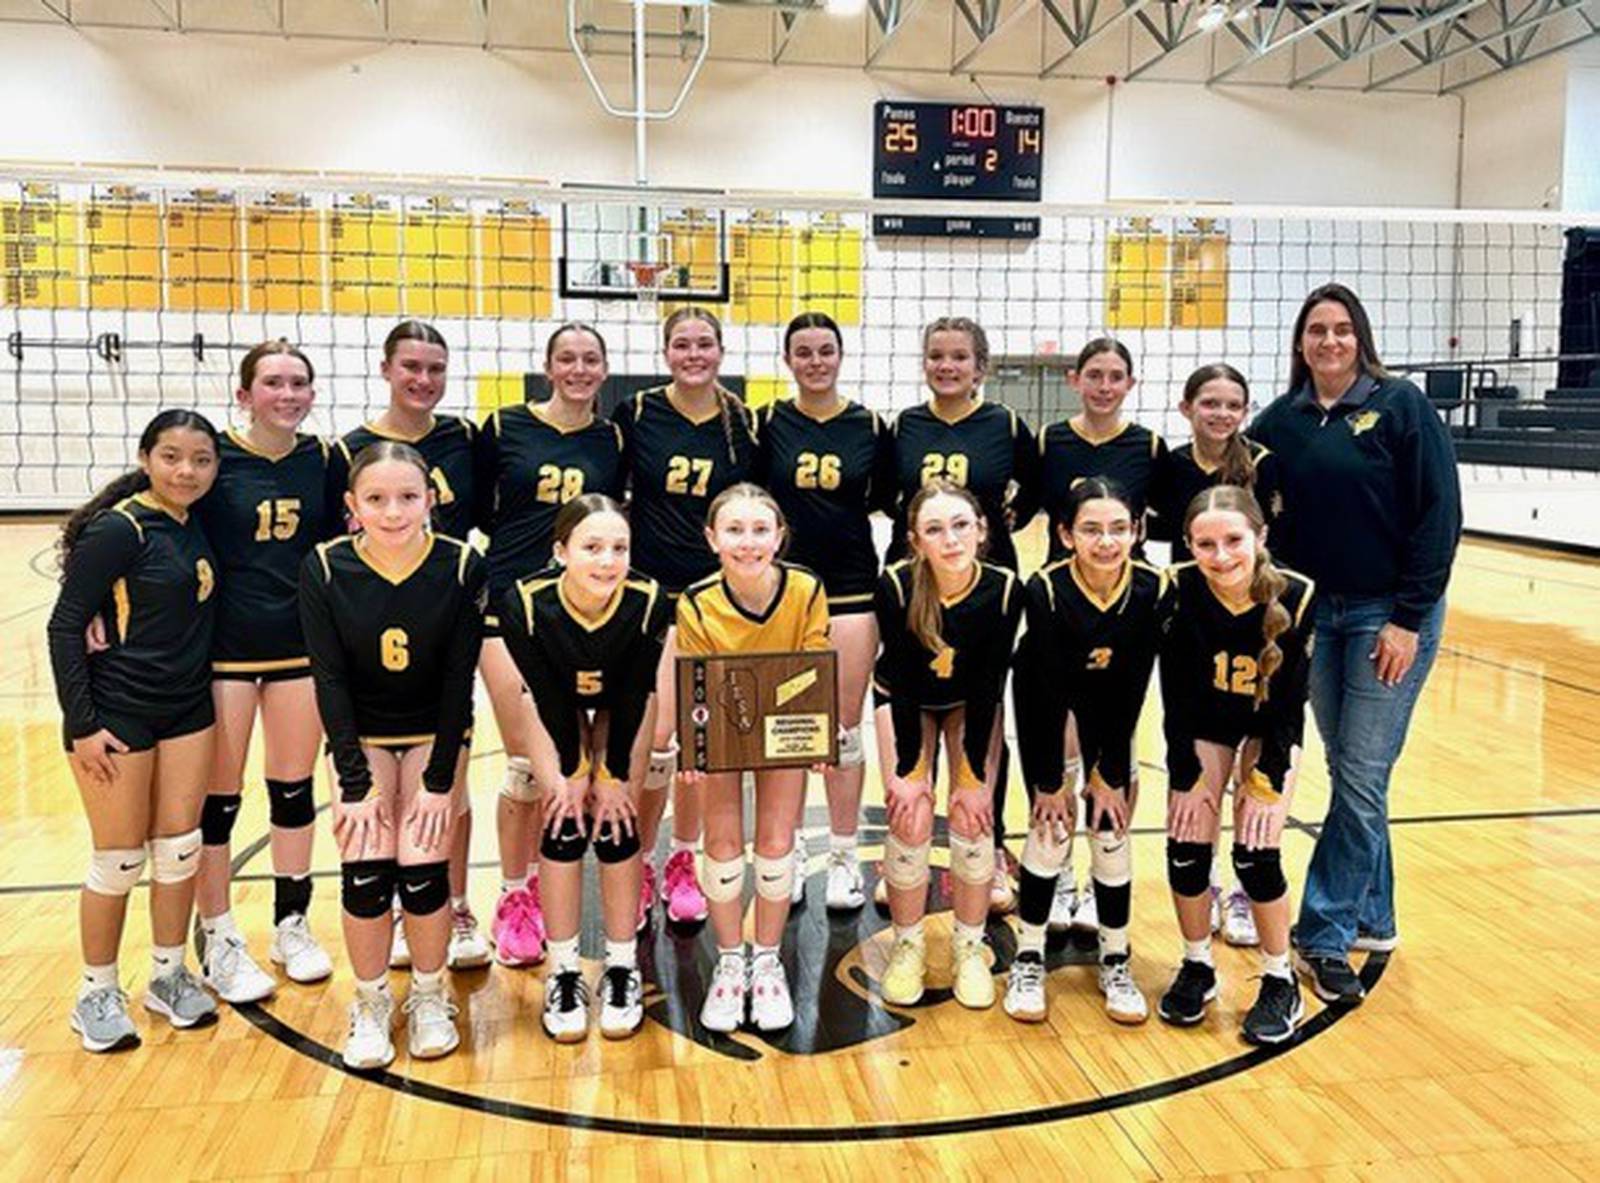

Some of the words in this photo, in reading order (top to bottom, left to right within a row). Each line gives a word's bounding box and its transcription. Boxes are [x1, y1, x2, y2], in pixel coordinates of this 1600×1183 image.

[885, 123, 917, 151] 25
[952, 107, 996, 137] 1:00
[1018, 129, 1040, 154] 14
[944, 154, 977, 167] period
[985, 150, 998, 171] 2
[943, 174, 976, 187] player
[430, 466, 455, 504] 1
[665, 456, 713, 496] 27
[795, 452, 841, 490] 26
[921, 453, 968, 488] 29
[255, 499, 300, 542] 15
[380, 628, 409, 671] 6
[930, 647, 954, 678] 4
[576, 670, 602, 695] 5
[1213, 650, 1258, 695] 12
